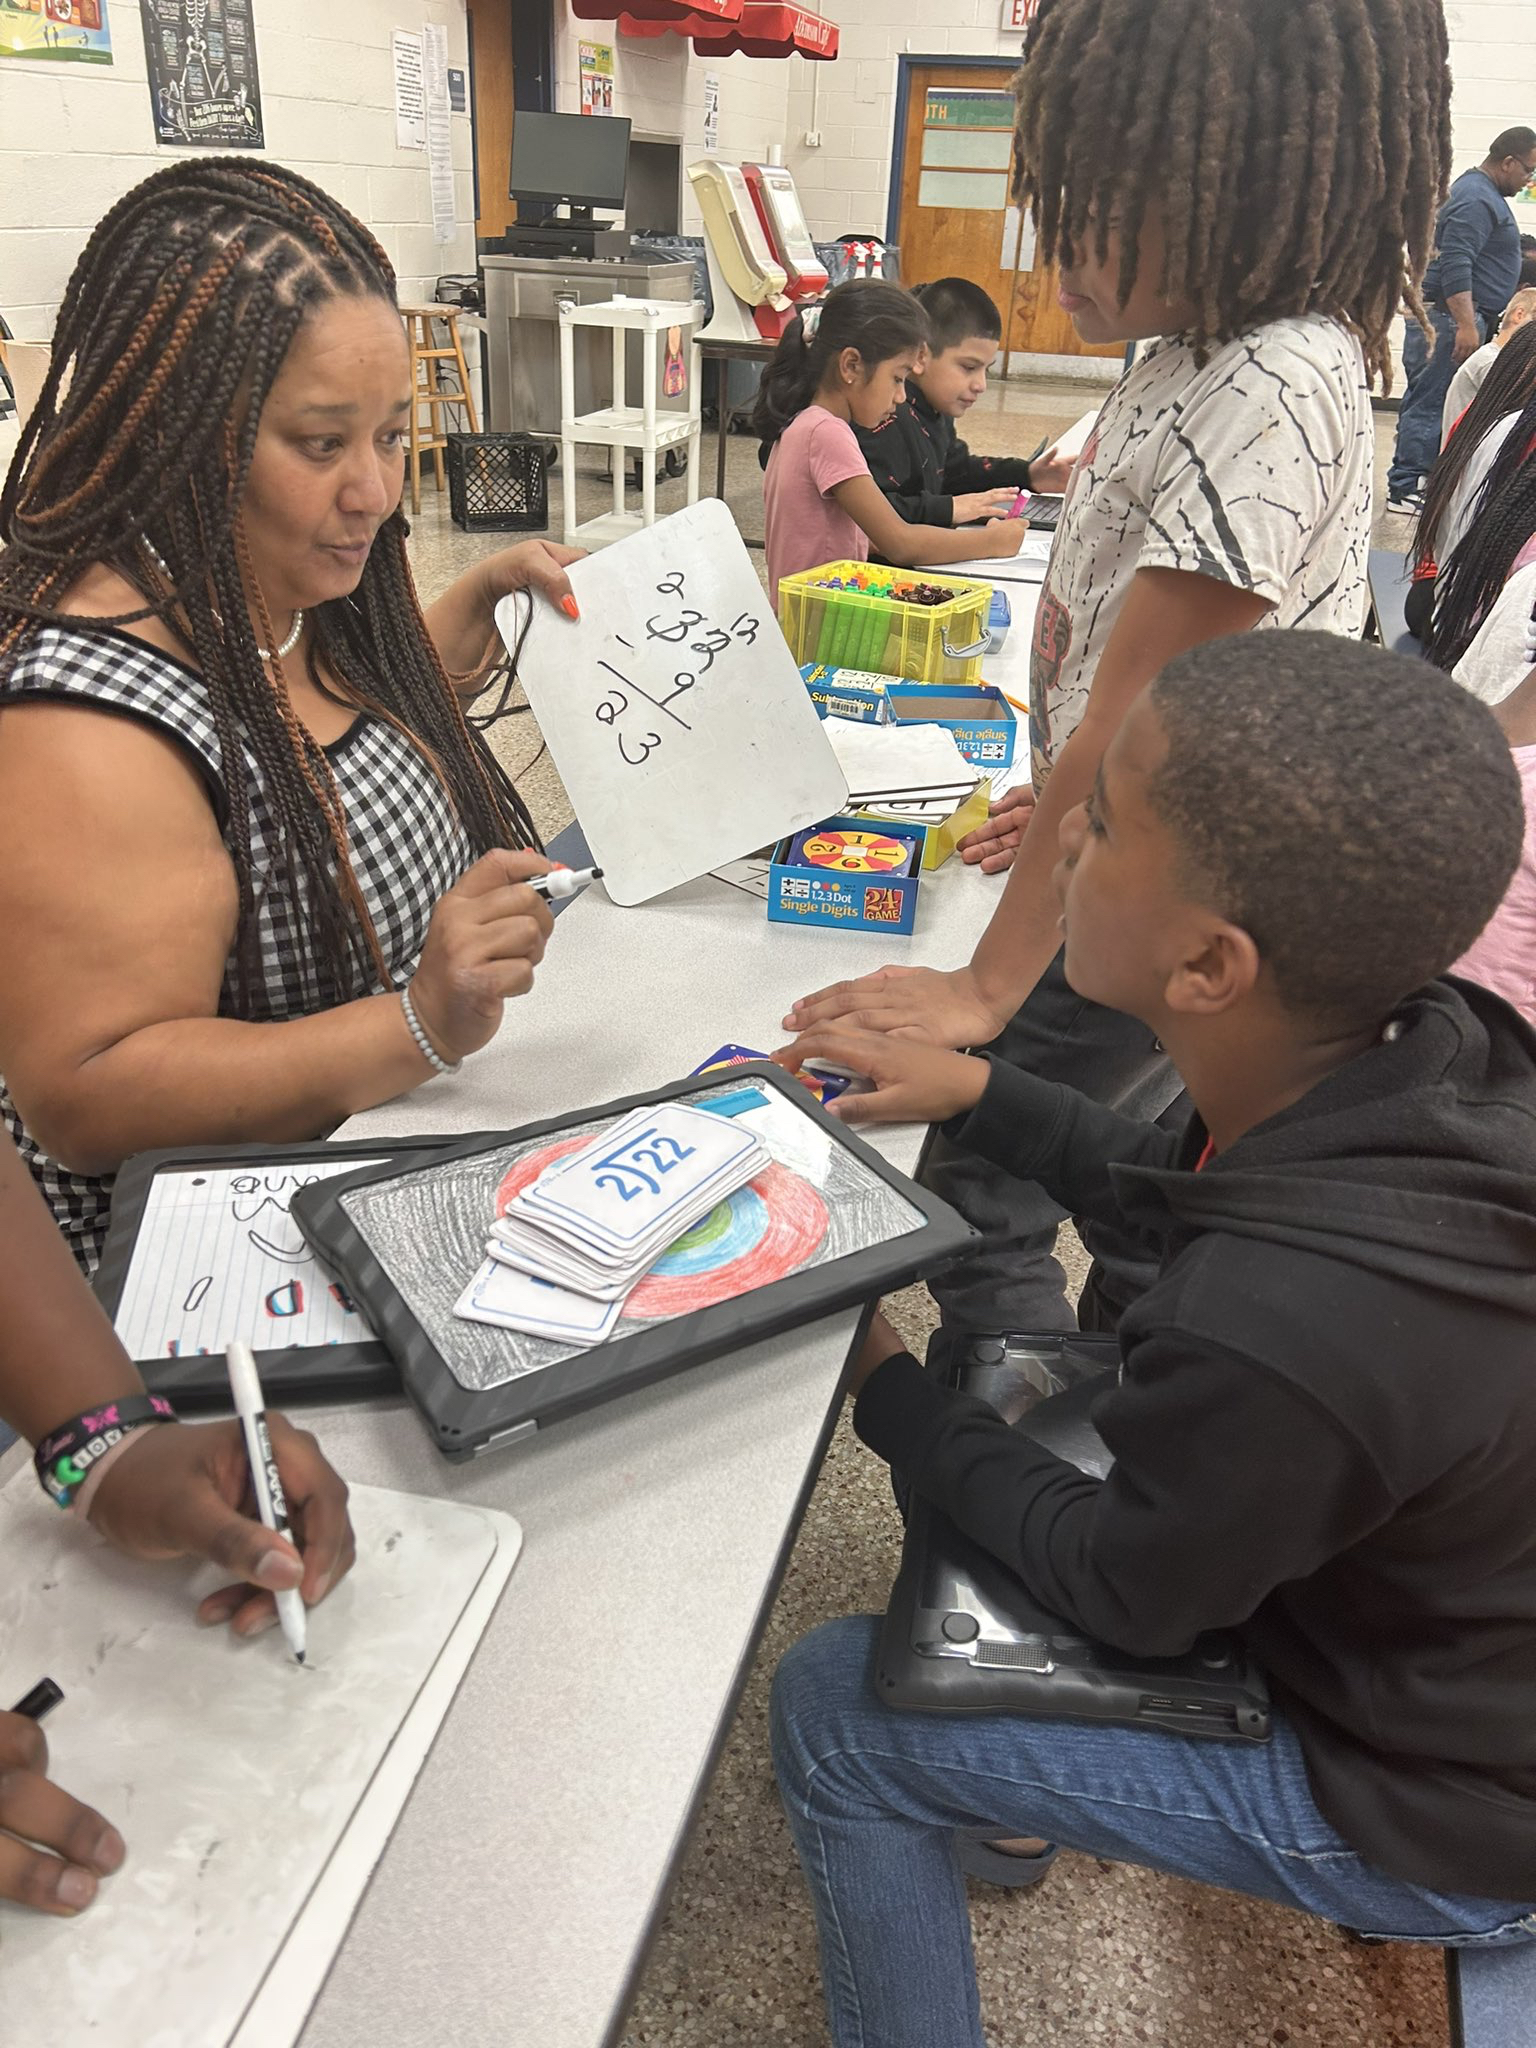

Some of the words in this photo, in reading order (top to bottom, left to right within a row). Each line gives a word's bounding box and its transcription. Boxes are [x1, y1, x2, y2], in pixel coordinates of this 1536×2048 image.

[833, 892, 852, 904] Dot
[865, 888, 899, 911] 24
[780, 898, 818, 914] Single
[821, 902, 859, 918] Digits
[866, 909, 900, 921] GAME
